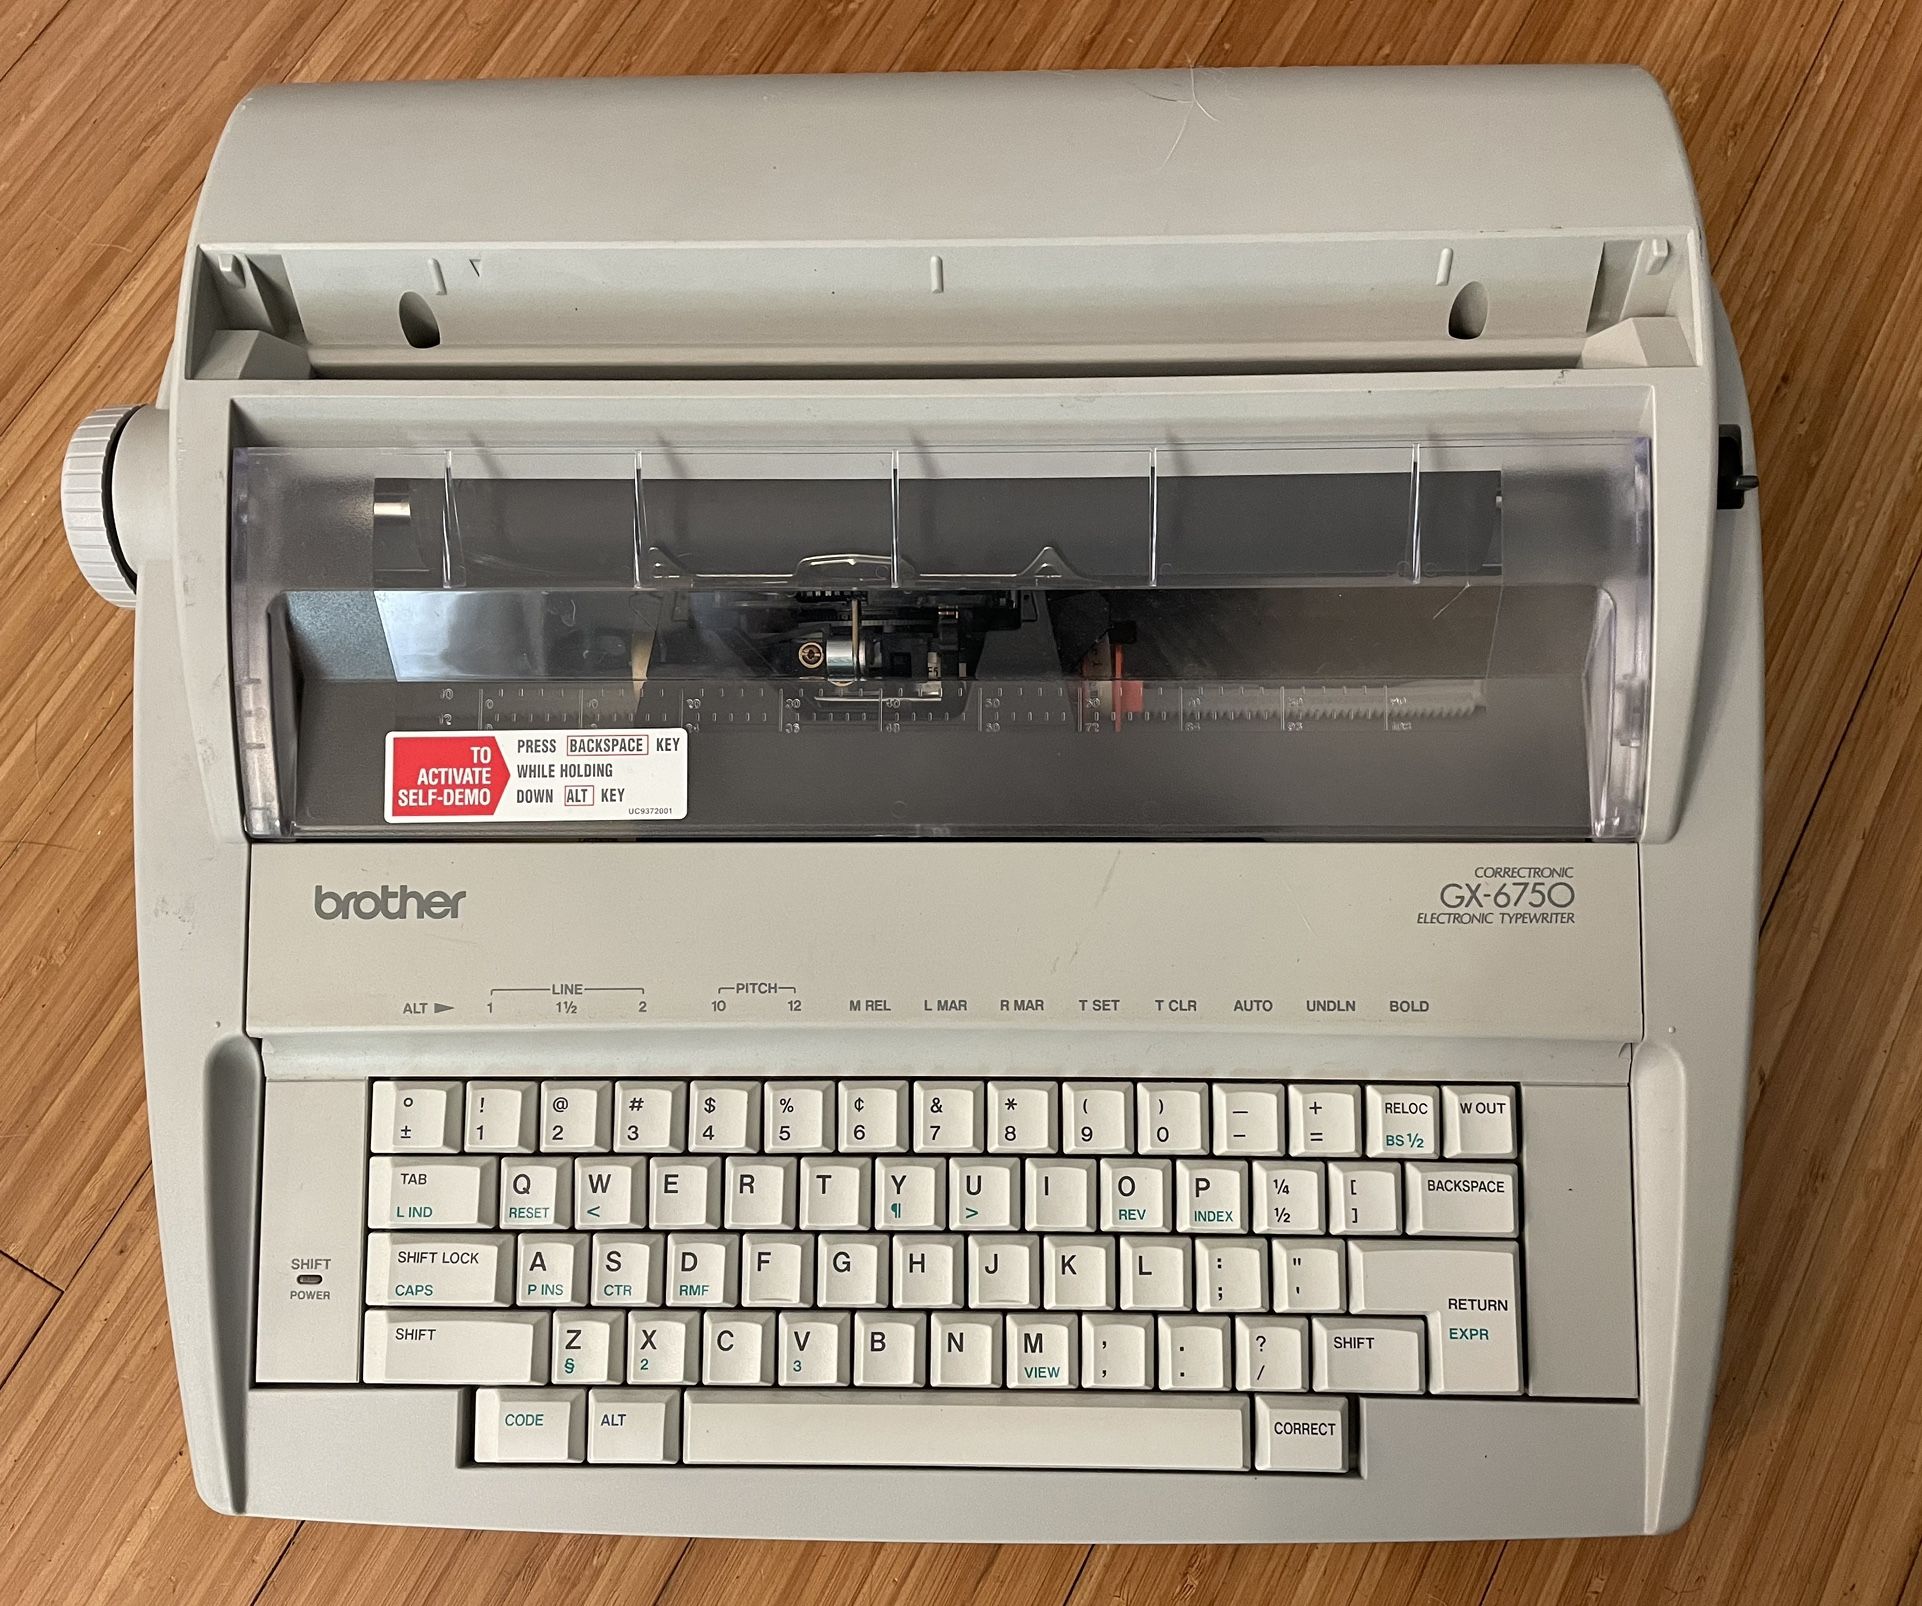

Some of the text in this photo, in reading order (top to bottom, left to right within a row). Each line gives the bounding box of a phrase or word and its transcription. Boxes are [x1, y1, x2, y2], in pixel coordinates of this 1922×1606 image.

[517, 737, 680, 754] PRESS BACKSPACE KEY
[470, 746, 492, 764] TO
[416, 767, 492, 786] ACTIVATE
[516, 762, 613, 779] WHILE HOLDING
[397, 787, 491, 807] SELF-DEMO
[516, 787, 625, 804] DOWN ALT KEY
[628, 807, 672, 815] UC9372001
[1474, 866, 1575, 879] CORRECTRONIC
[314, 884, 467, 921] brother
[1440, 881, 1575, 909] GX-6750
[1416, 912, 1576, 925] ELECTRONIC TYPEWRITER
[551, 983, 584, 995] LINE
[736, 982, 778, 995] PITCH
[402, 1002, 429, 1015] ALT
[486, 1002, 493, 1014] 1
[638, 1000, 648, 1013] 2
[711, 999, 727, 1012] 10
[787, 999, 802, 1012] 12
[849, 999, 892, 1012] M REL
[924, 999, 968, 1012] L MAR
[1000, 999, 1045, 1012] R MAR
[1078, 999, 1121, 1012] T SET
[1154, 999, 1197, 1012] T CLR
[1233, 999, 1273, 1012] AUTO
[1306, 999, 1356, 1012] UNDLN
[1389, 1000, 1430, 1013] BOLD
[479, 1097, 485, 1113] !
[552, 1096, 569, 1113] @
[628, 1097, 645, 1112] #
[703, 1096, 716, 1114] $
[779, 1097, 794, 1114] %
[930, 1097, 943, 1114] &
[1082, 1098, 1088, 1115] (
[1158, 1098, 1164, 1115] )
[1308, 1101, 1323, 1115] +
[1384, 1102, 1428, 1115] RELOC
[1459, 1101, 1507, 1115] W OUT
[400, 1125, 412, 1139] ±
[476, 1124, 484, 1141] 1
[551, 1124, 564, 1141] 2
[627, 1124, 639, 1141] 3
[702, 1124, 715, 1141] 4
[778, 1125, 791, 1141] 5
[853, 1124, 866, 1141] 6
[929, 1125, 941, 1141] 7
[1004, 1125, 1017, 1142] 8
[1081, 1126, 1093, 1143] 9
[1156, 1126, 1170, 1143] 0
[1309, 1132, 1324, 1142] =
[1385, 1134, 1405, 1147] BS
[400, 1172, 427, 1185] TAB
[512, 1173, 531, 1195] Q
[587, 1173, 612, 1194] W
[663, 1173, 679, 1194] E
[739, 1173, 755, 1194] R
[815, 1174, 832, 1195] T
[890, 1174, 907, 1195] Y
[966, 1174, 982, 1196] U
[1044, 1175, 1049, 1196] I
[1117, 1175, 1136, 1197] O
[1427, 1179, 1505, 1193] BACKSPACE
[1195, 1177, 1211, 1198] P
[1350, 1179, 1357, 1196] [
[396, 1206, 433, 1218] L IND
[508, 1206, 550, 1219] RESET
[586, 1205, 601, 1218] <
[890, 1202, 901, 1219] ¶
[965, 1207, 979, 1219] >
[1118, 1208, 1147, 1221] REV
[1194, 1210, 1234, 1222] INDEX
[1351, 1207, 1358, 1224] ]
[290, 1258, 332, 1271] SHIFT
[397, 1250, 480, 1265] SHIFT LOCK
[529, 1251, 547, 1272] A
[605, 1250, 622, 1273] S
[680, 1251, 698, 1272] D
[757, 1251, 772, 1272] F
[832, 1251, 851, 1273] G
[909, 1252, 925, 1274] H
[984, 1253, 999, 1275] J
[1061, 1254, 1077, 1276] K
[1138, 1255, 1153, 1276] L
[1292, 1257, 1302, 1266] "
[289, 1290, 331, 1300] POWER
[395, 1284, 434, 1297] CAPS
[527, 1283, 564, 1296] P INS
[603, 1284, 632, 1297] CTR
[679, 1284, 709, 1297] RMF
[1448, 1297, 1508, 1312] RETURN
[395, 1327, 437, 1341] SHIFT
[564, 1329, 582, 1350] Z
[639, 1329, 657, 1350] X
[716, 1329, 734, 1352] C
[793, 1330, 811, 1352] V
[870, 1331, 886, 1352] B
[947, 1331, 964, 1353] N
[1449, 1327, 1489, 1341] EXPR
[1023, 1332, 1043, 1354] M
[1255, 1335, 1267, 1353] ?
[1333, 1336, 1375, 1350] SHIFT
[564, 1357, 575, 1374] §
[640, 1358, 649, 1371] 2
[792, 1359, 802, 1373] 3
[1023, 1366, 1061, 1379] VIEW
[1256, 1364, 1265, 1381] /
[504, 1413, 545, 1427] CODE
[600, 1413, 627, 1427] ALT
[1273, 1421, 1337, 1436] CORRECT
